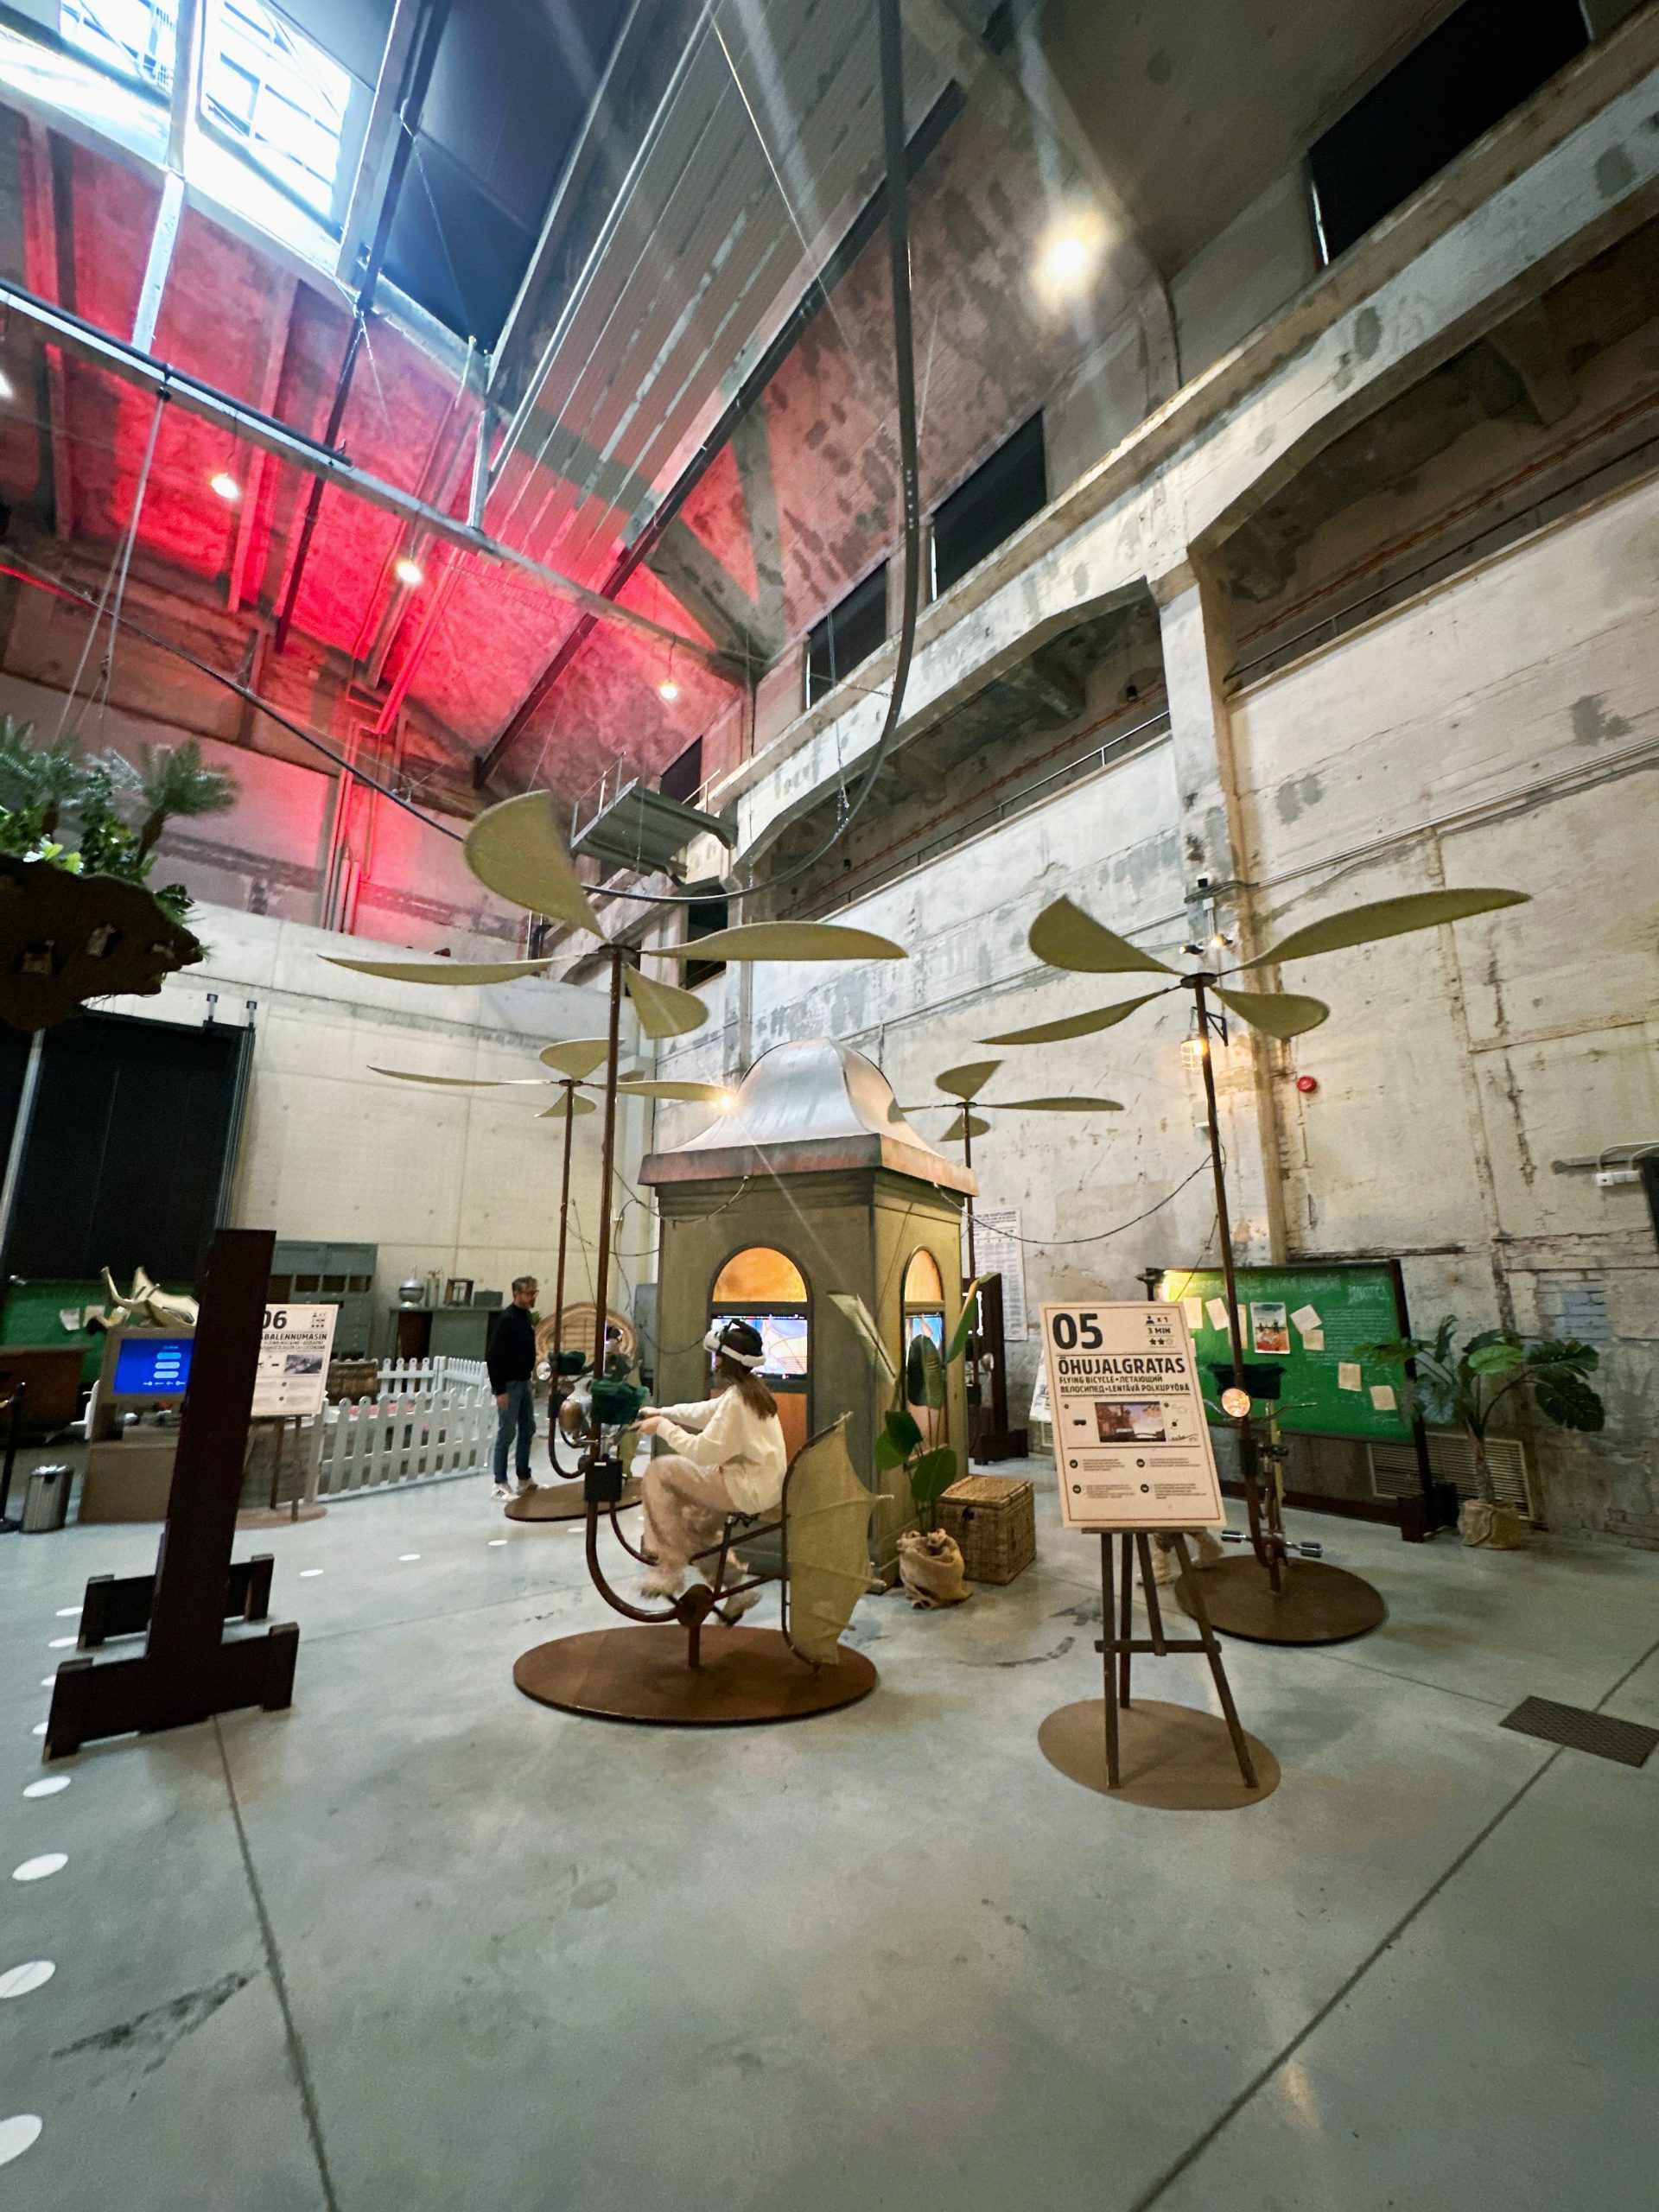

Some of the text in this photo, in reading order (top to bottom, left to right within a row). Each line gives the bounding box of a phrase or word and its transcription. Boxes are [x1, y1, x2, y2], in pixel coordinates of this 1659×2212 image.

[263, 1310, 287, 1329] 06
[1052, 1313, 1103, 1350] 05
[1058, 1357, 1185, 1375] ÕHUJALGRATAS
[1120, 1374, 1163, 1383] ЛЕТАЮЩИЙ
